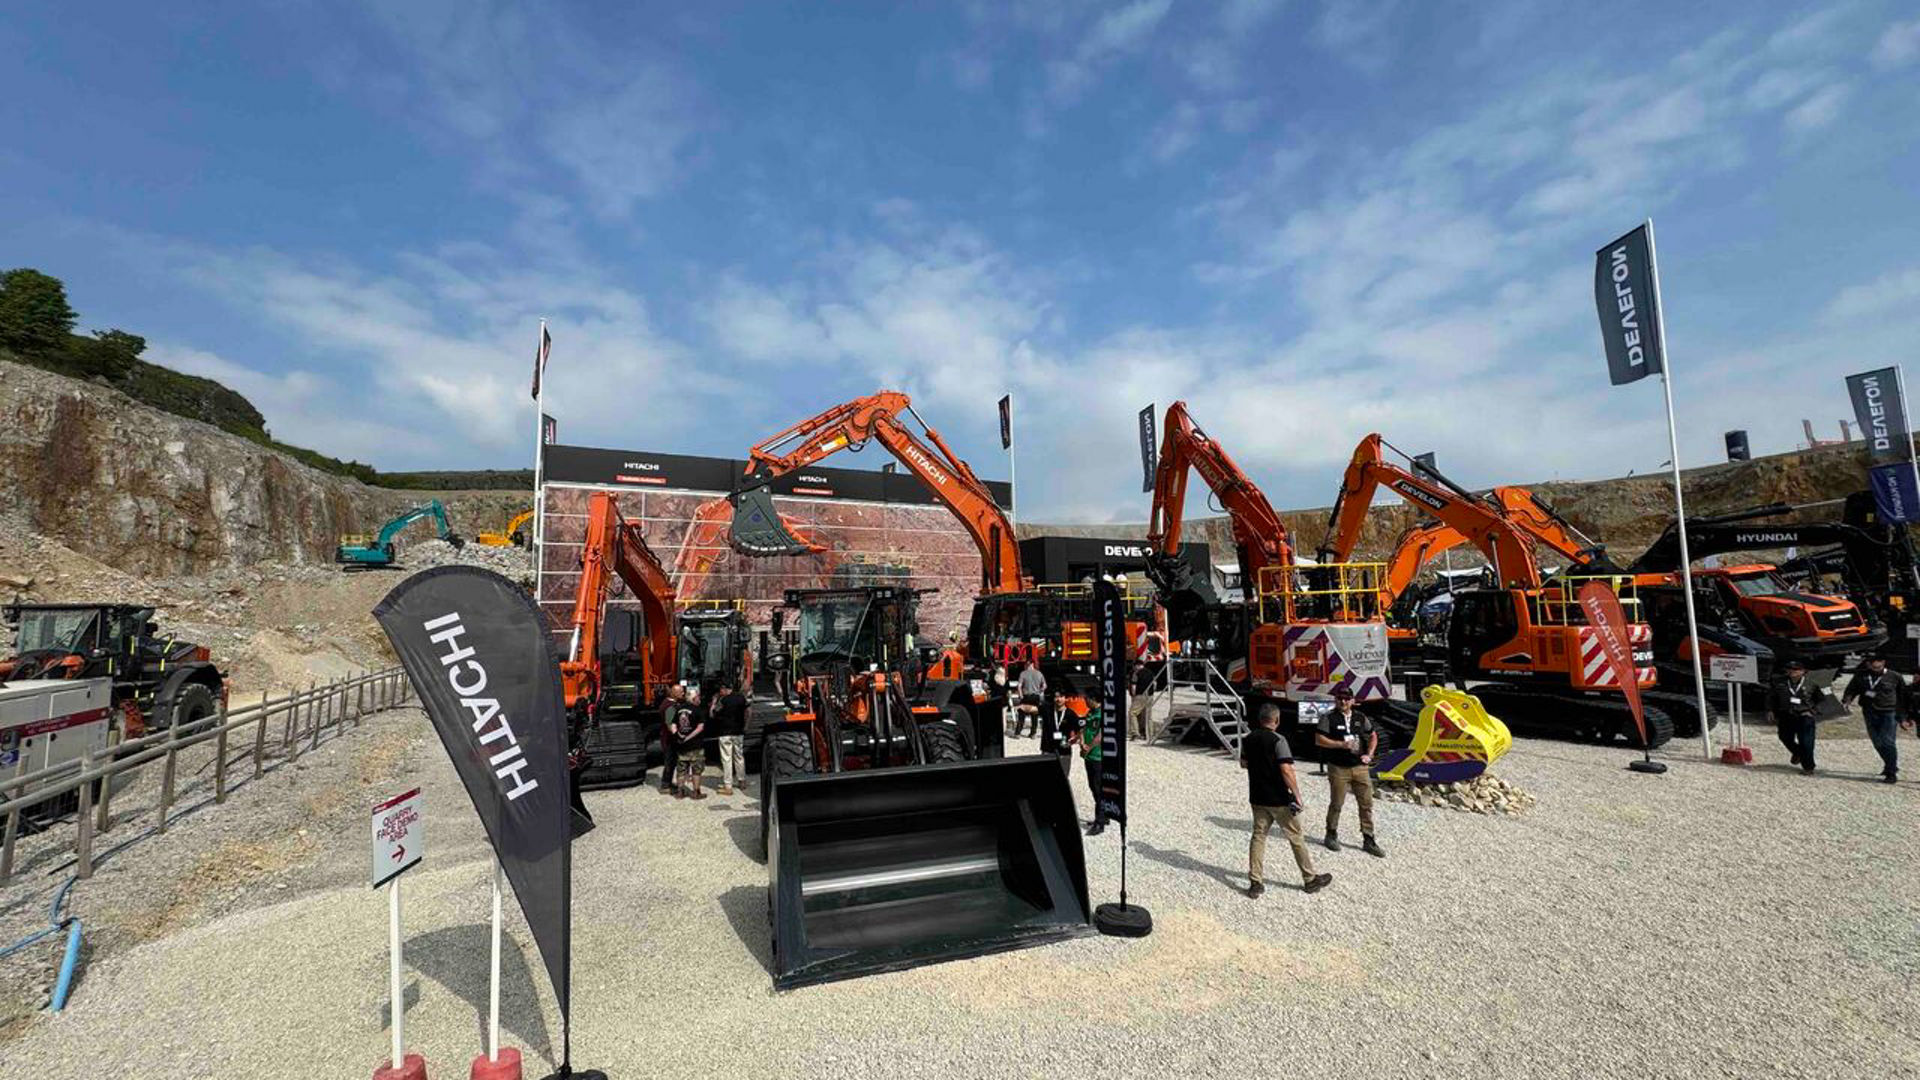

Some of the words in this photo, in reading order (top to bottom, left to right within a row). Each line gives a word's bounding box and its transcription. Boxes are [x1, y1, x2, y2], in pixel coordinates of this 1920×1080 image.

[624, 462, 660, 470] HITACHI
[905, 446, 947, 485] HITACHI
[1192, 453, 1226, 491] HITACHI
[799, 475, 828, 483] HITACHI
[1401, 483, 1442, 509] DEVELON
[1736, 533, 1798, 543] HYUNDAI
[383, 806, 412, 827] QUARRY
